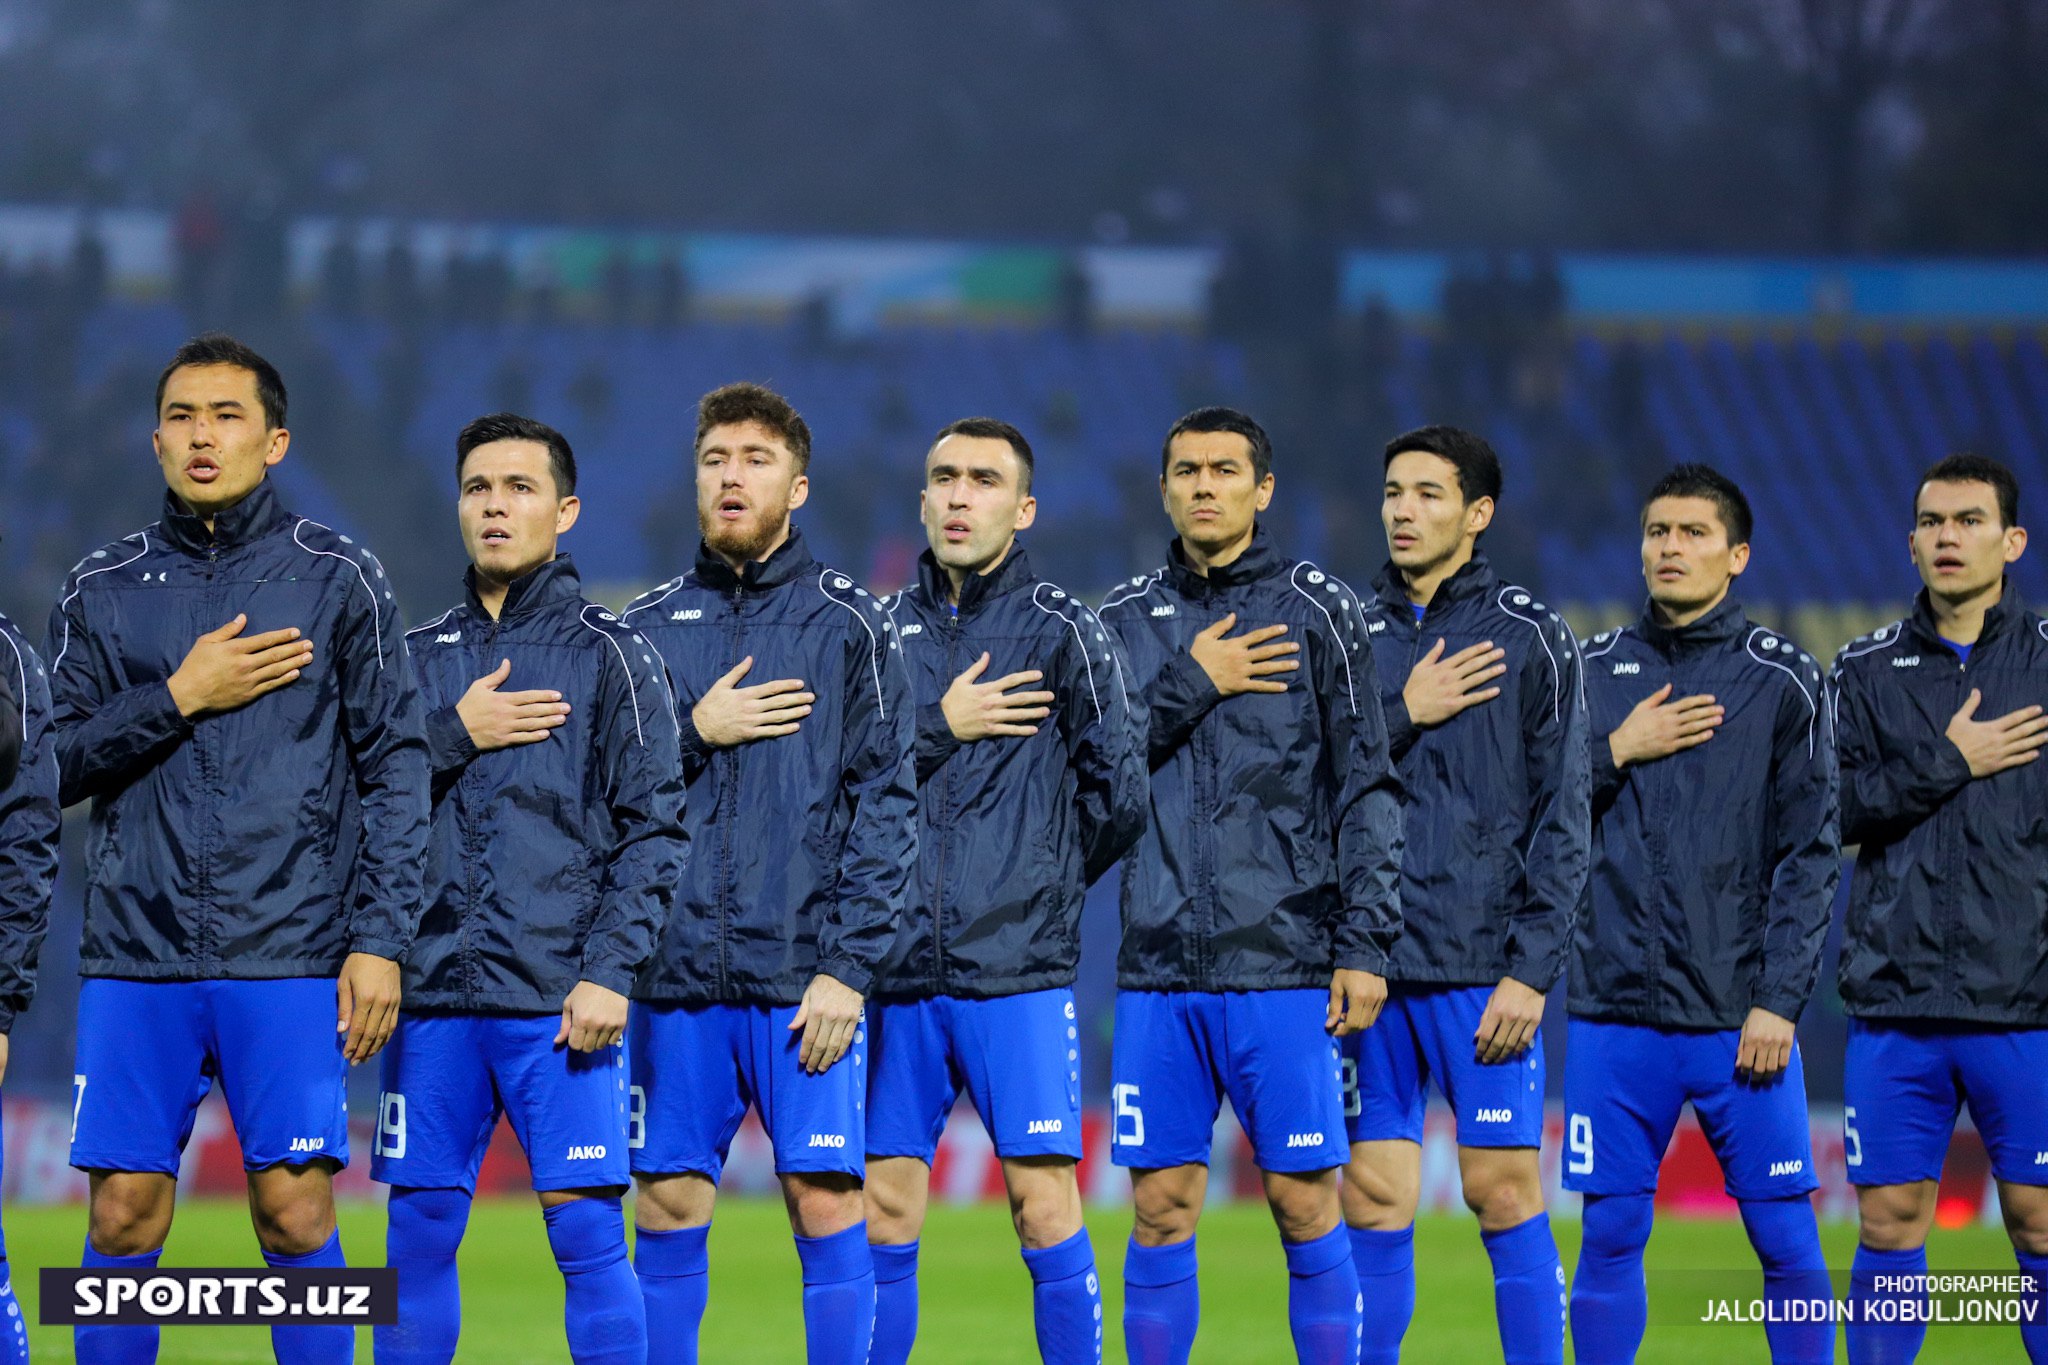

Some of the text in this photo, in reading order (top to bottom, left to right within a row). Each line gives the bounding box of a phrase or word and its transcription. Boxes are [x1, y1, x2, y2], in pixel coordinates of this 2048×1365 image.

[671, 609, 702, 621] JAKO
[1612, 662, 1640, 675] JAKO
[1892, 655, 1920, 667] JAKO
[1110, 1082, 1145, 1147] 15
[1475, 1108, 1513, 1123] JAKO
[375, 1091, 407, 1159] 19
[1027, 1118, 1063, 1135] JAKO
[289, 1137, 325, 1152] JAKO
[808, 1133, 846, 1149] JAKO
[1286, 1132, 1324, 1148] JAKO
[1568, 1113, 1594, 1175] 9
[566, 1144, 607, 1161] JAKO
[2034, 1151, 2048, 1165] JA
[1769, 1159, 1803, 1177] JAKO
